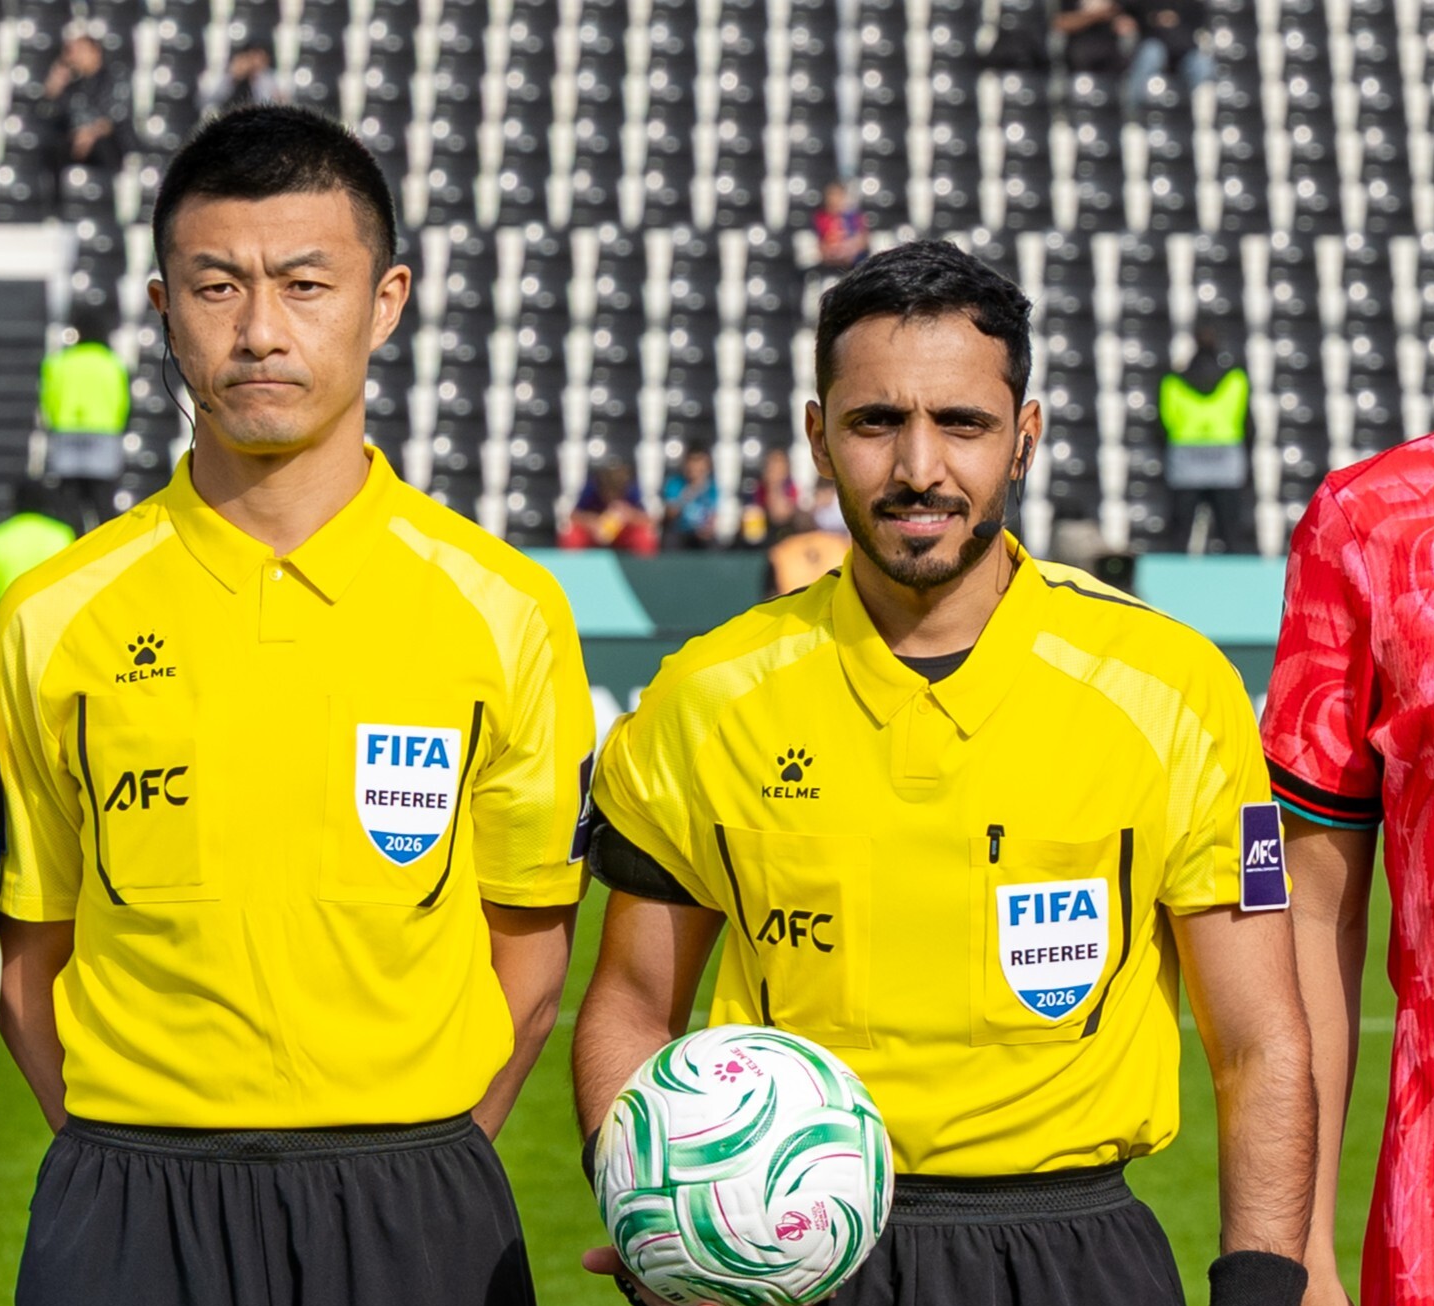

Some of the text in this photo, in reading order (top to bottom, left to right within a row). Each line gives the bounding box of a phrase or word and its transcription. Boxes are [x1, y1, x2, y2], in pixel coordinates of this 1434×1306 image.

[115, 667, 176, 684] KELME
[367, 734, 450, 769] FIFA
[104, 766, 188, 812] AFC
[365, 790, 447, 809] REFEREE
[762, 787, 820, 799] KELME
[385, 836, 422, 853] 2026
[1246, 839, 1278, 866] AFC
[1009, 890, 1097, 927] FIFA
[757, 909, 834, 953] AFC
[1011, 943, 1099, 966] REFEREE
[1037, 989, 1076, 1009] 2026
